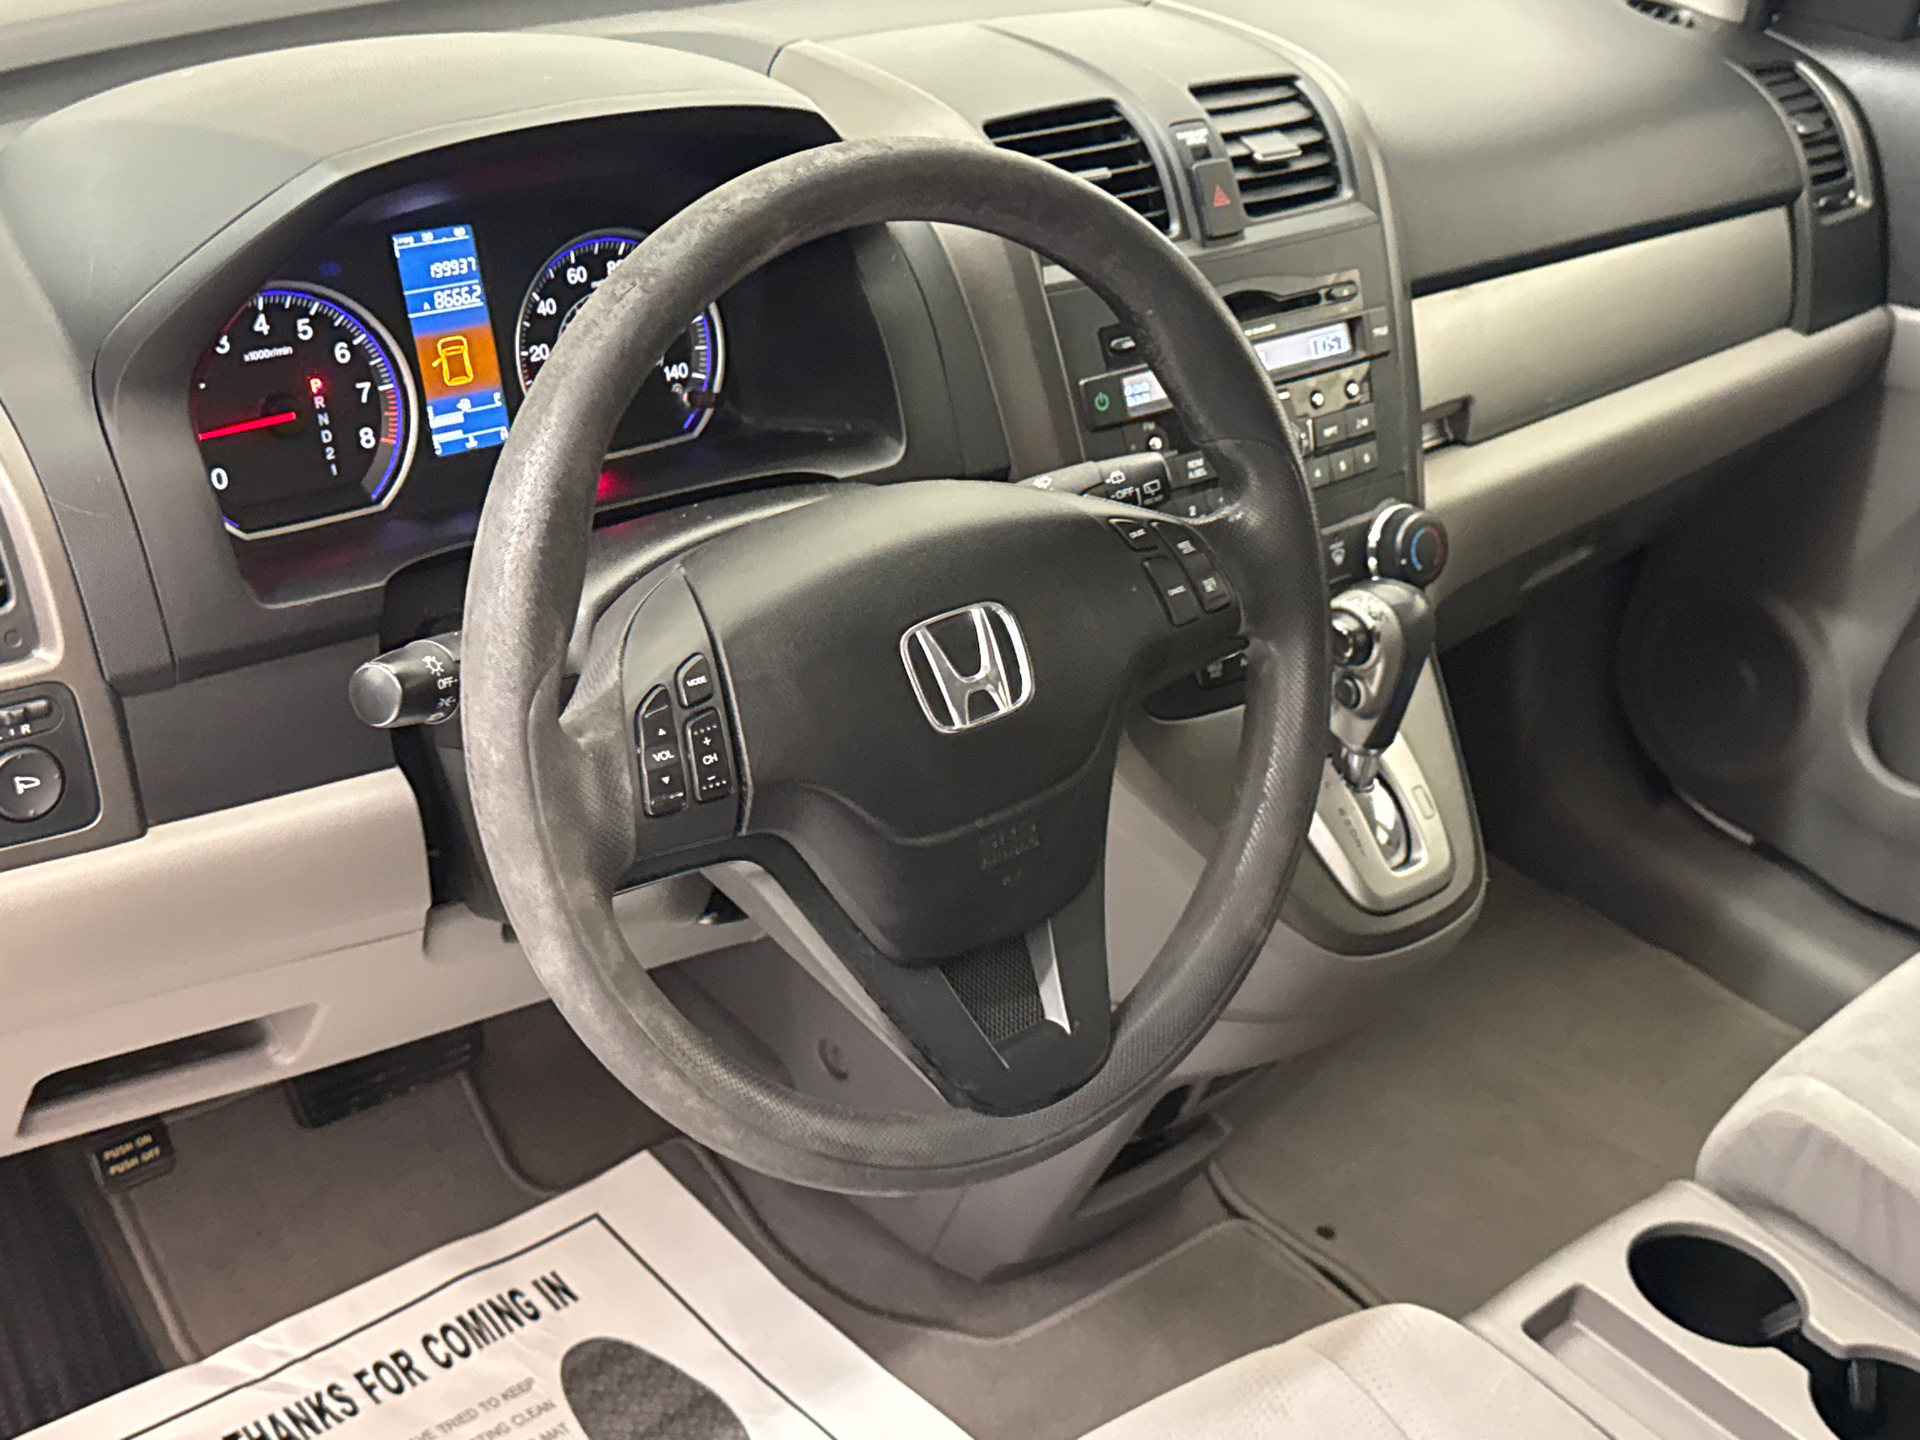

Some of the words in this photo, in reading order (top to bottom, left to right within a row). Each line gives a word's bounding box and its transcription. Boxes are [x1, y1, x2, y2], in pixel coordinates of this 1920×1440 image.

[430, 256, 477, 279] 199937
[566, 265, 588, 285] 60
[606, 259, 624, 276] 8
[536, 298, 557, 316] 40
[253, 313, 270, 335] 4
[296, 317, 314, 341] 5
[215, 335, 231, 354] 3
[334, 341, 351, 364] 6
[529, 343, 550, 362] 20
[663, 362, 689, 382] 140
[310, 378, 323, 394] P
[355, 381, 371, 403] 7
[313, 396, 326, 409] R
[317, 412, 330, 426] N
[321, 429, 332, 443] D
[358, 426, 376, 449] 8
[325, 446, 336, 460] 2
[210, 468, 228, 490] 0
[330, 463, 338, 476] 1
[1115, 486, 1134, 500] OFF
[437, 676, 453, 690] OFF
[686, 675, 707, 687] MODE
[652, 749, 675, 762] VOL
[702, 752, 719, 766] CH
[103, 1141, 134, 1161] PUSH
[135, 1133, 153, 1148] ON
[109, 1156, 139, 1176] PUSH
[141, 1146, 160, 1162] OFF
[353, 1349, 429, 1405] FOR
[421, 1288, 541, 1369] COMING
[531, 1270, 580, 1312] IN
[435, 1407, 478, 1434] TRIED
[477, 1396, 500, 1413] TO
[501, 1376, 535, 1401] KEEP
[511, 1398, 557, 1427] CLEAN
